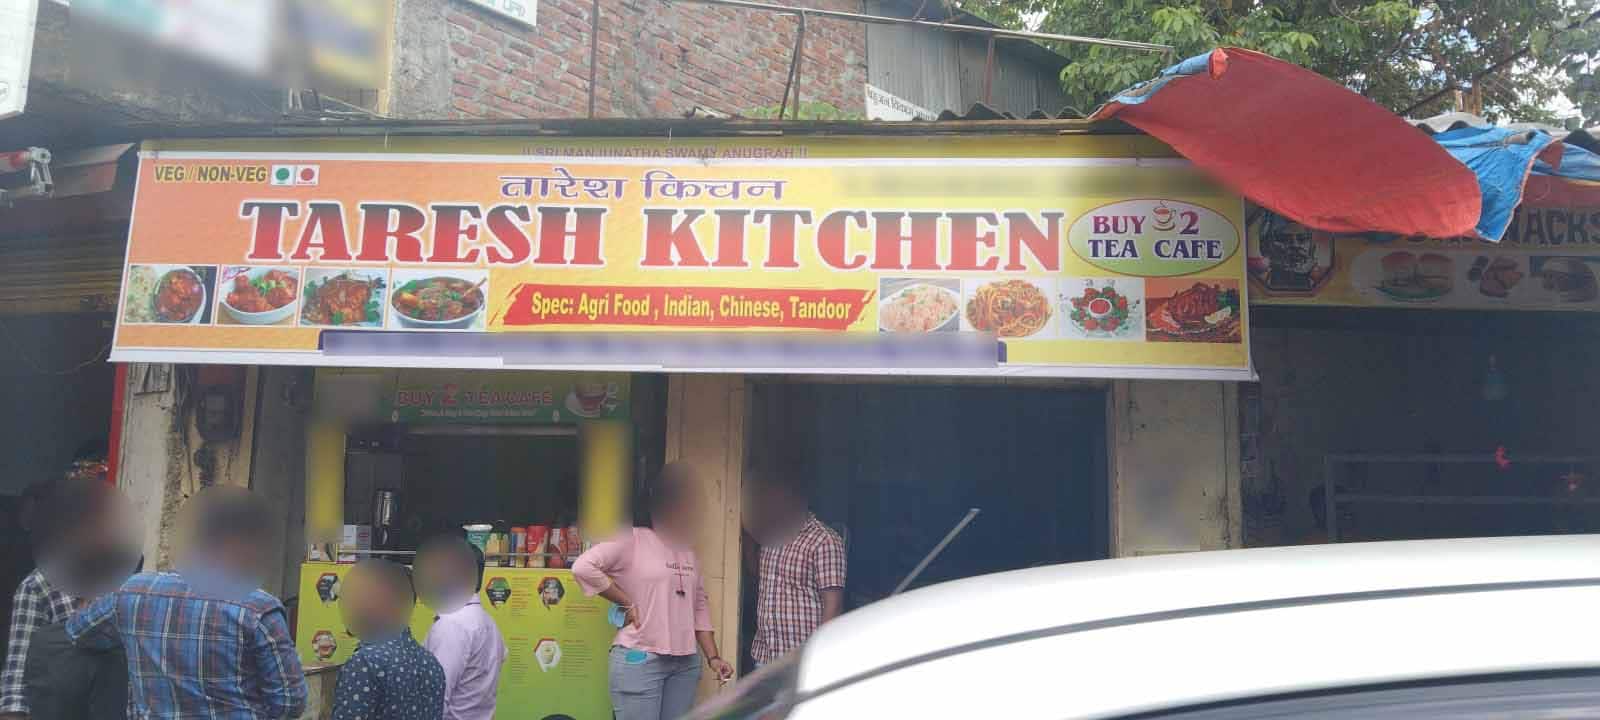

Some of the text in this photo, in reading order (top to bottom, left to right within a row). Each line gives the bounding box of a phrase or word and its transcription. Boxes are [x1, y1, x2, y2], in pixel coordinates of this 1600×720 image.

[535, 146, 560, 157] SRI
[665, 146, 718, 159] SWAMY
[721, 147, 794, 159] ANUGRAH
[154, 165, 185, 181] VEG
[197, 166, 267, 182] NON-VEG
[499, 167, 788, 200] तारेश किचन
[1092, 209, 1200, 236] BUY 2
[241, 201, 1065, 272] TARESH KITCHEN
[1087, 239, 1223, 260] TEA CAFE
[531, 293, 574, 318] Spec:
[577, 294, 609, 320] Agri
[613, 295, 650, 316] Food
[663, 295, 715, 321] Indian,
[719, 296, 785, 322] Chinese,
[789, 297, 852, 319] Tandoor
